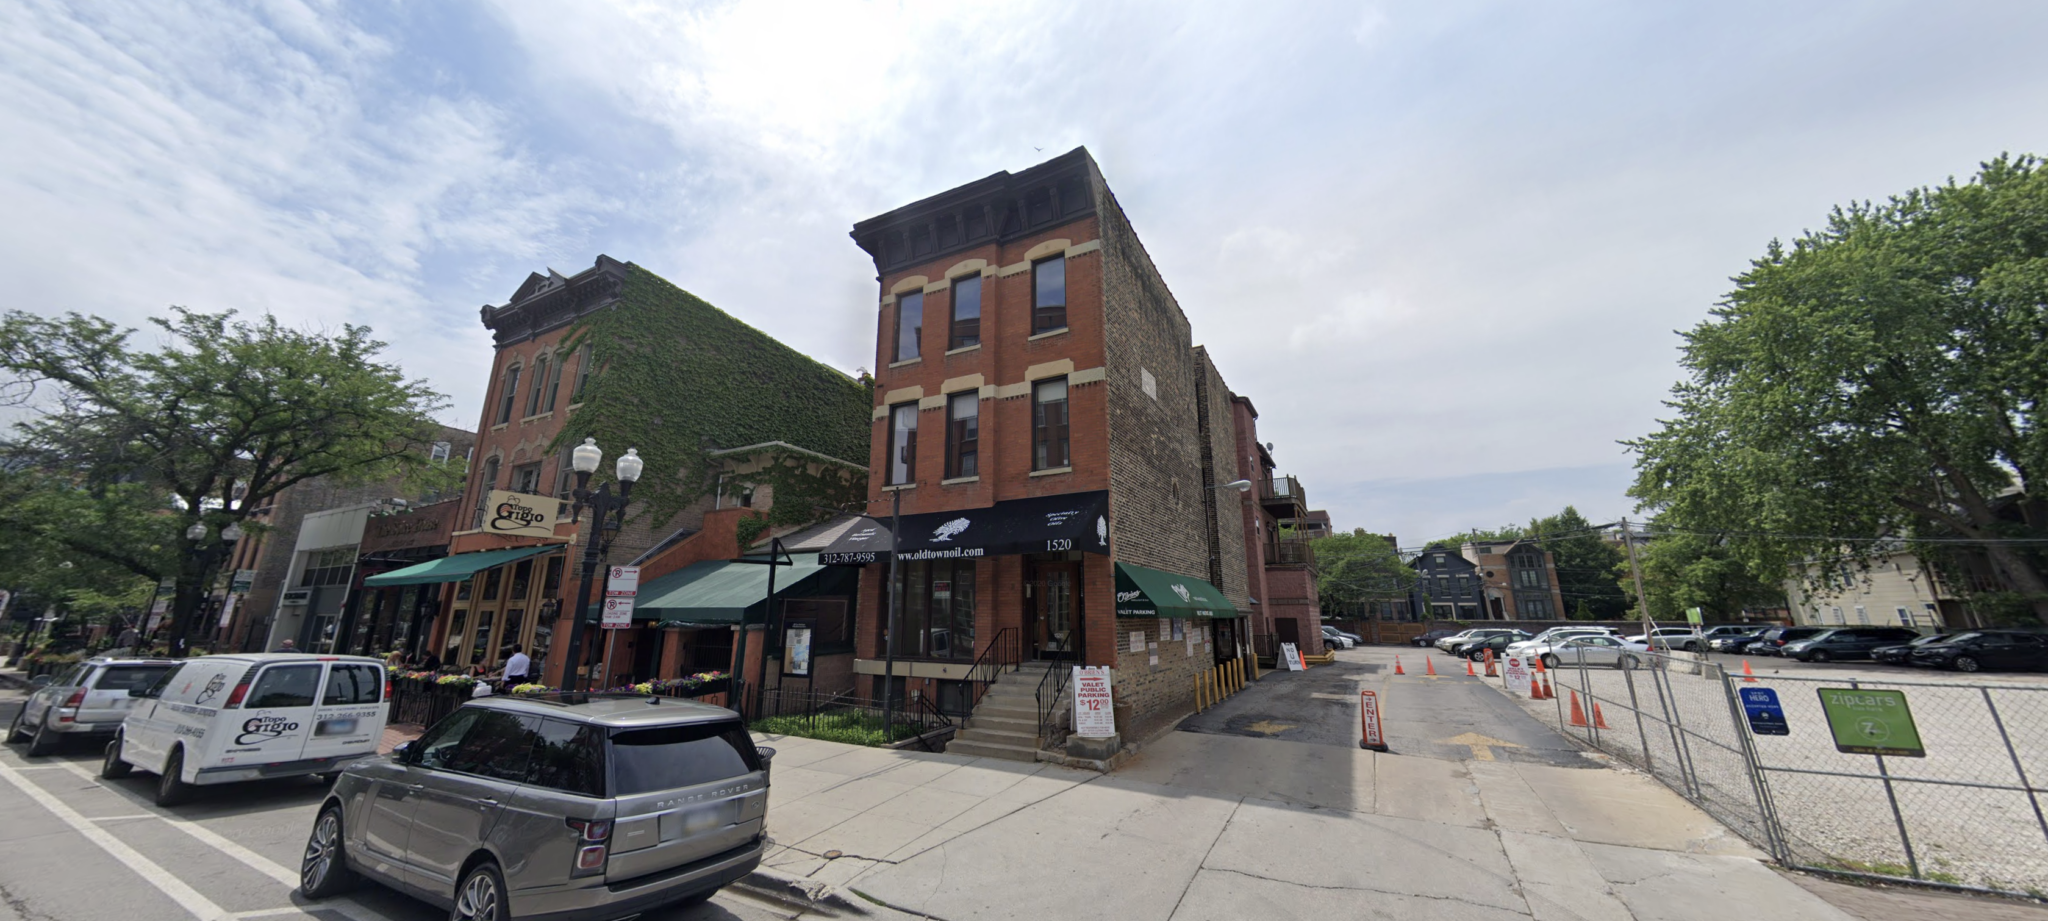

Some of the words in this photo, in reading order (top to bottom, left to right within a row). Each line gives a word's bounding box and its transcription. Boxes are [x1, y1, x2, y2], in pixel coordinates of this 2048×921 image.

[494, 503, 544, 526] Gigio
[512, 503, 533, 514] Topo
[1046, 538, 1072, 551] 1520
[823, 552, 876, 564] 312-787-9595
[1829, 692, 1896, 708] zipcars
[262, 715, 287, 724] Topo
[1365, 702, 1377, 737] ENTER
[239, 716, 299, 740] Gigio
[657, 795, 703, 808] RANGE
[711, 784, 748, 797] ROVER
